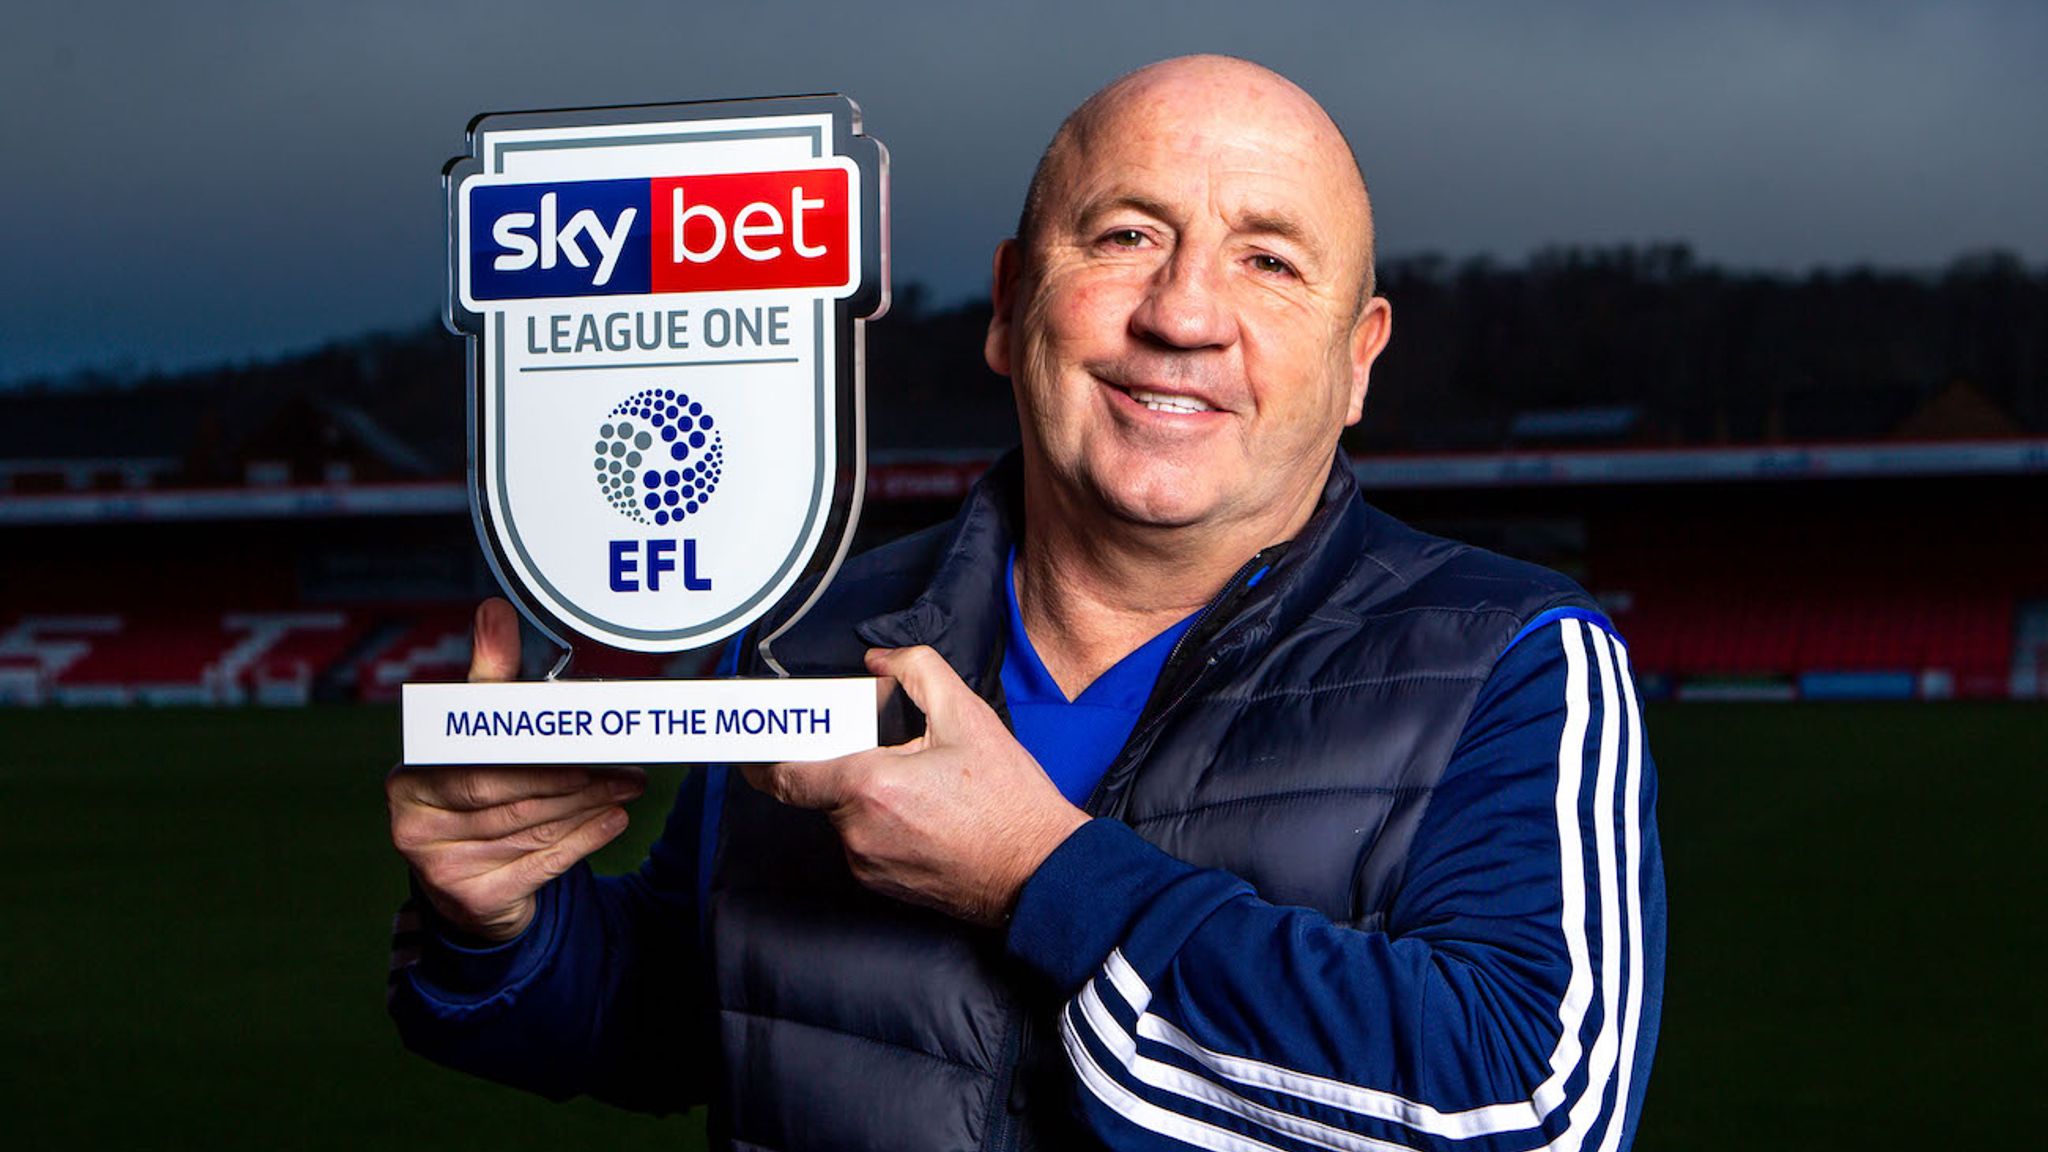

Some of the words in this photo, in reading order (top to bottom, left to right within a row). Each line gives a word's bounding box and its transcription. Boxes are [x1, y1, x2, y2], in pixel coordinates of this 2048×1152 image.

[493, 192, 638, 287] sky
[672, 187, 827, 263] bet
[527, 310, 690, 355] LEAGUE
[703, 305, 790, 350] ONE
[609, 538, 712, 593] EFL
[445, 710, 593, 737] MANAGER
[600, 709, 641, 736] OF
[648, 709, 707, 735] THE
[715, 708, 831, 735] MONTH
